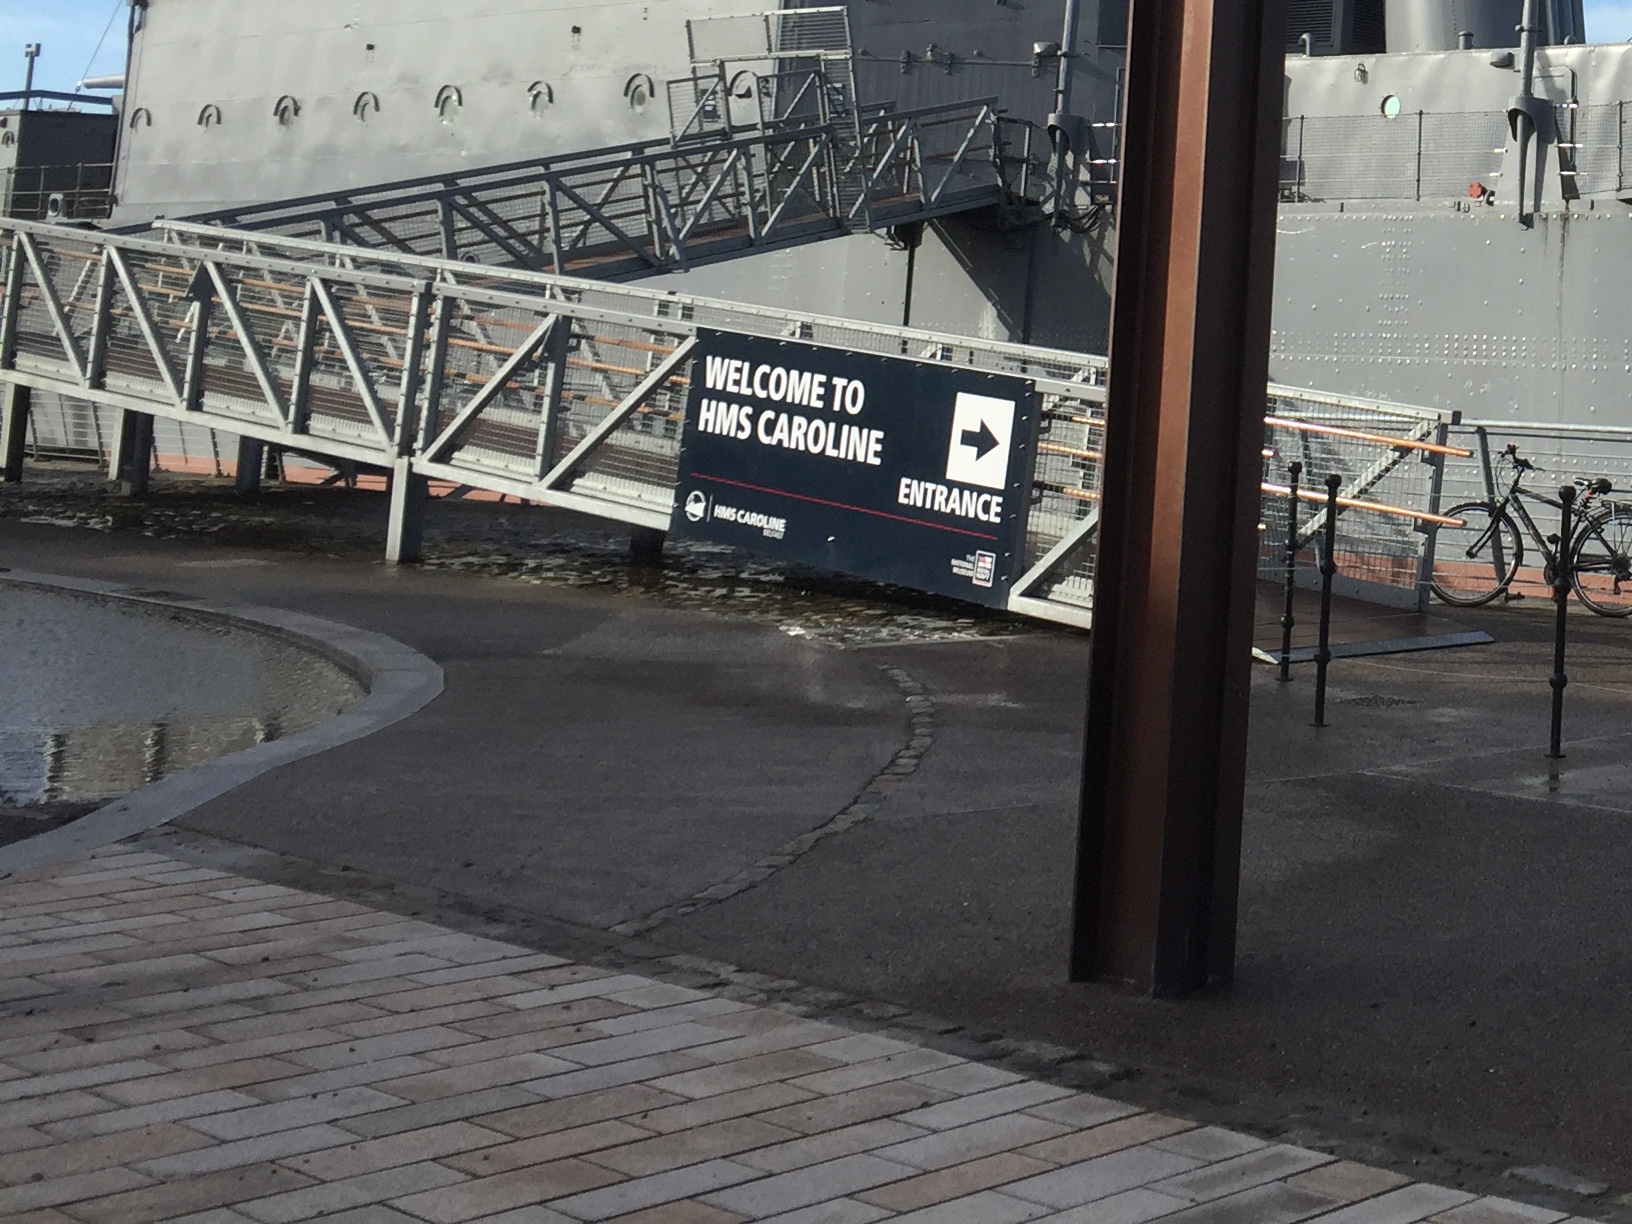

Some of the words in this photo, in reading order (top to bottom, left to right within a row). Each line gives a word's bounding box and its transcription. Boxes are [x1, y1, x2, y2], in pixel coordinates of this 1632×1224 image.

[705, 355, 827, 408] WELCOME
[832, 377, 865, 415] TO
[698, 398, 753, 440] HMS
[757, 409, 884, 466] CAROLINE
[714, 504, 737, 522] HMS
[737, 510, 787, 532] CAROLINE
[898, 477, 1003, 523] ENTRANCE
